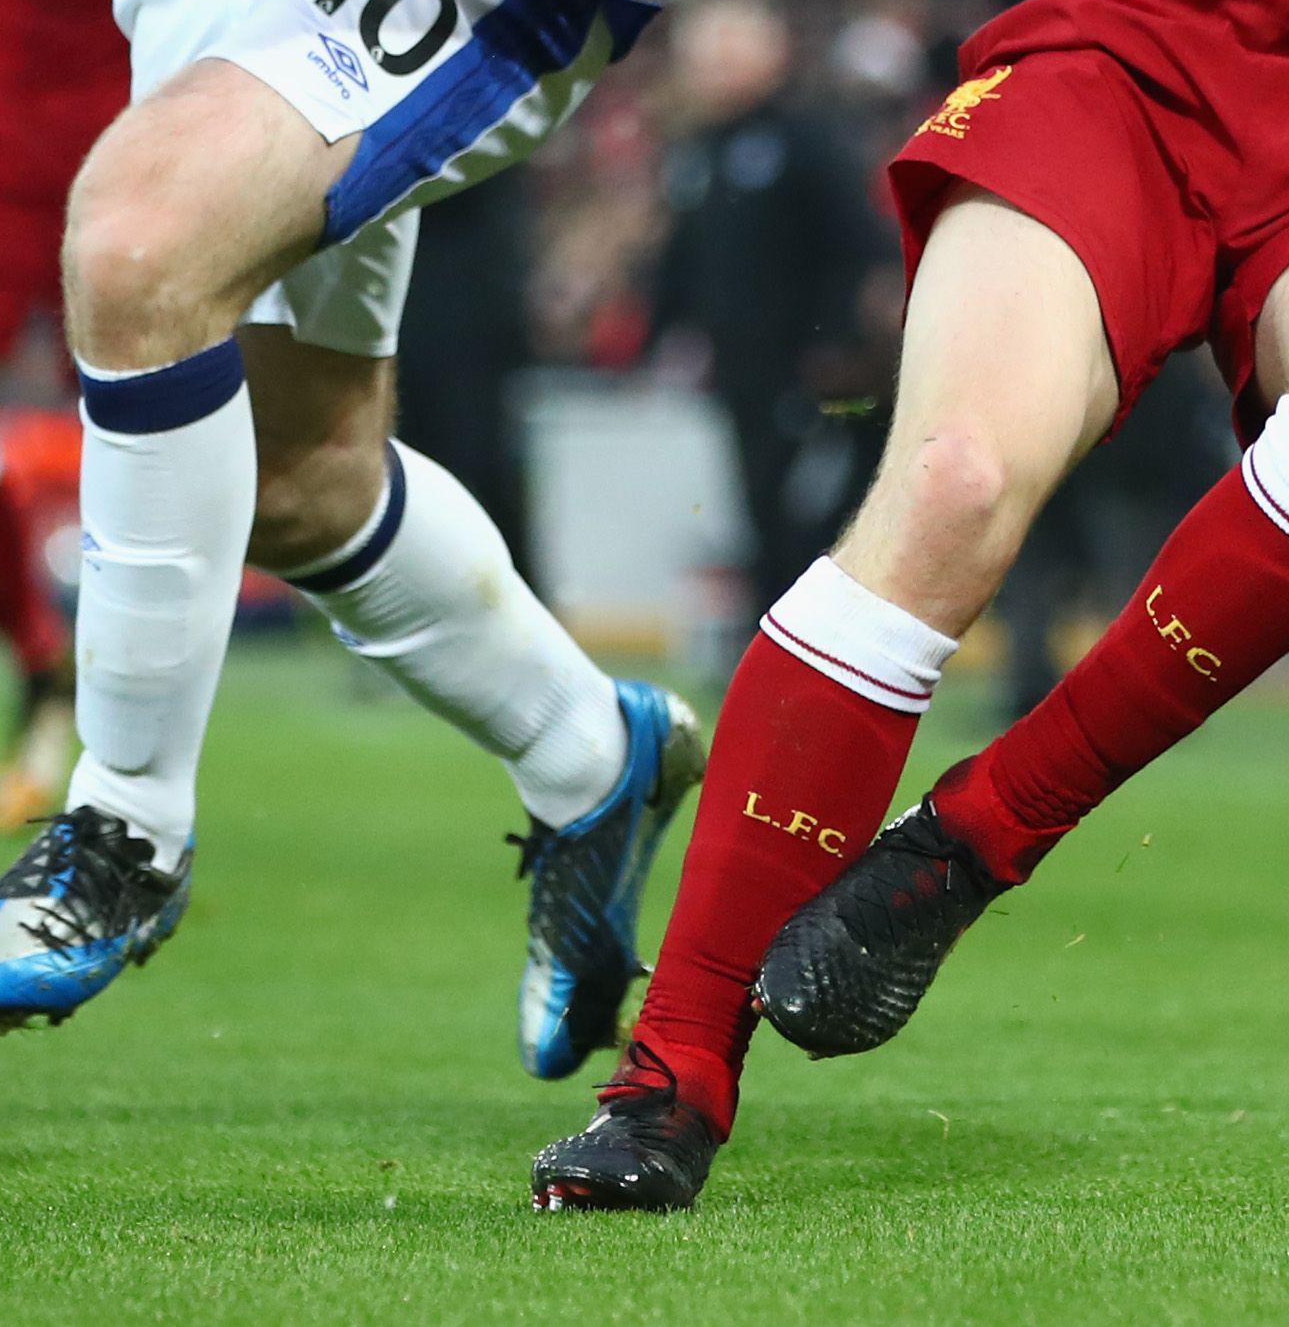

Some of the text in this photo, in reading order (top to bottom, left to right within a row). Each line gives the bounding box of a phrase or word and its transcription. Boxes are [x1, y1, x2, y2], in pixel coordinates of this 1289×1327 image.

[307, 50, 351, 100] umbro
[1146, 584, 1221, 682] L.F.C.
[742, 790, 846, 858] L.F.C.
